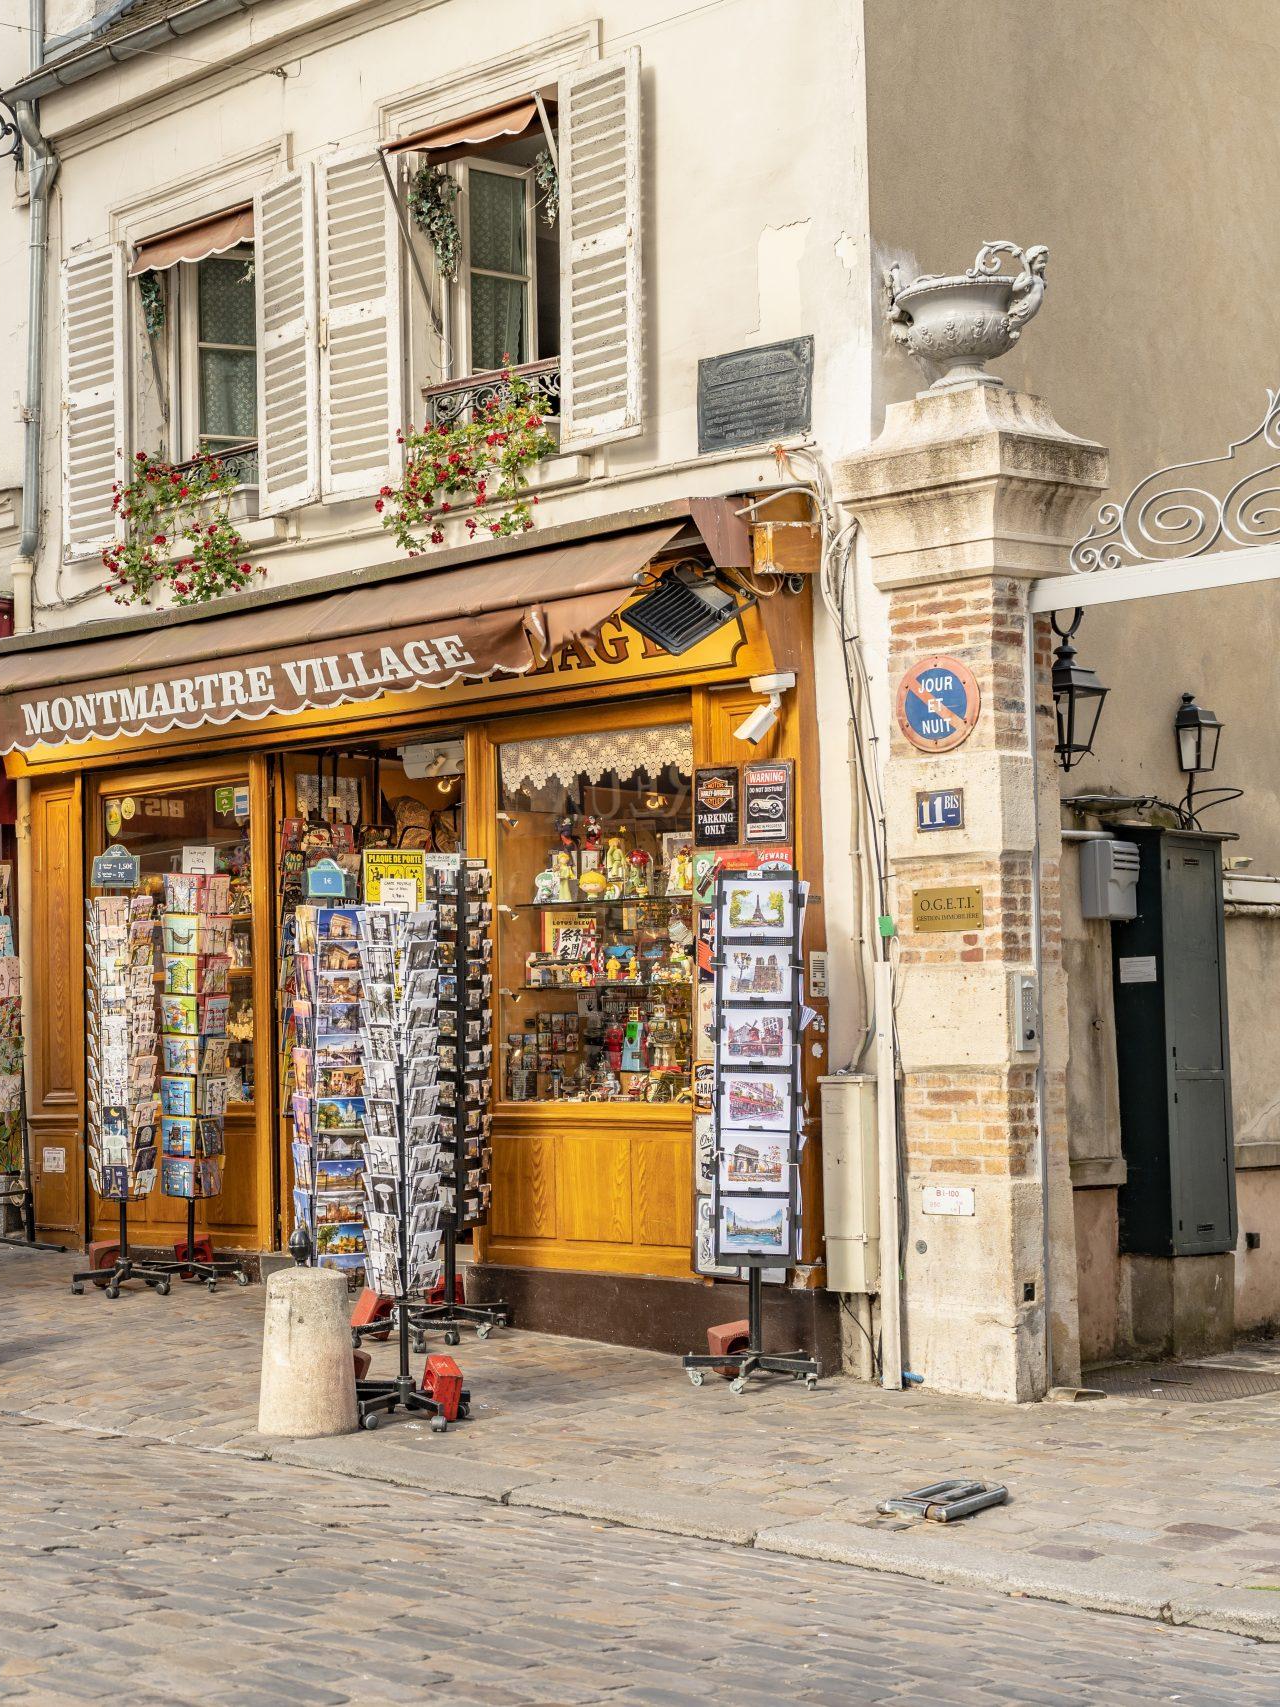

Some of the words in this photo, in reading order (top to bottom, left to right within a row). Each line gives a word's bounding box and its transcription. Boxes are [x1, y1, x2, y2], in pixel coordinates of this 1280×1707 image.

[21, 665, 275, 736] MONTMARTRE
[281, 634, 475, 697] VILLAGE
[918, 675, 953, 694] JOUR
[927, 698, 944, 713] ET
[922, 717, 952, 735] NUIT
[749, 770, 784, 784] WARNING
[920, 796, 946, 826] 11
[944, 794, 960, 810] BIS
[698, 812, 734, 825] PARKING
[704, 824, 726, 835] ONLY
[368, 854, 393, 864] PLAQUE
[393, 854, 402, 864] DE
[404, 854, 422, 864] PORTE
[323, 877, 332, 885] 1€
[919, 896, 975, 912] O.G.E.T.I.
[916, 914, 941, 922] GESTION
